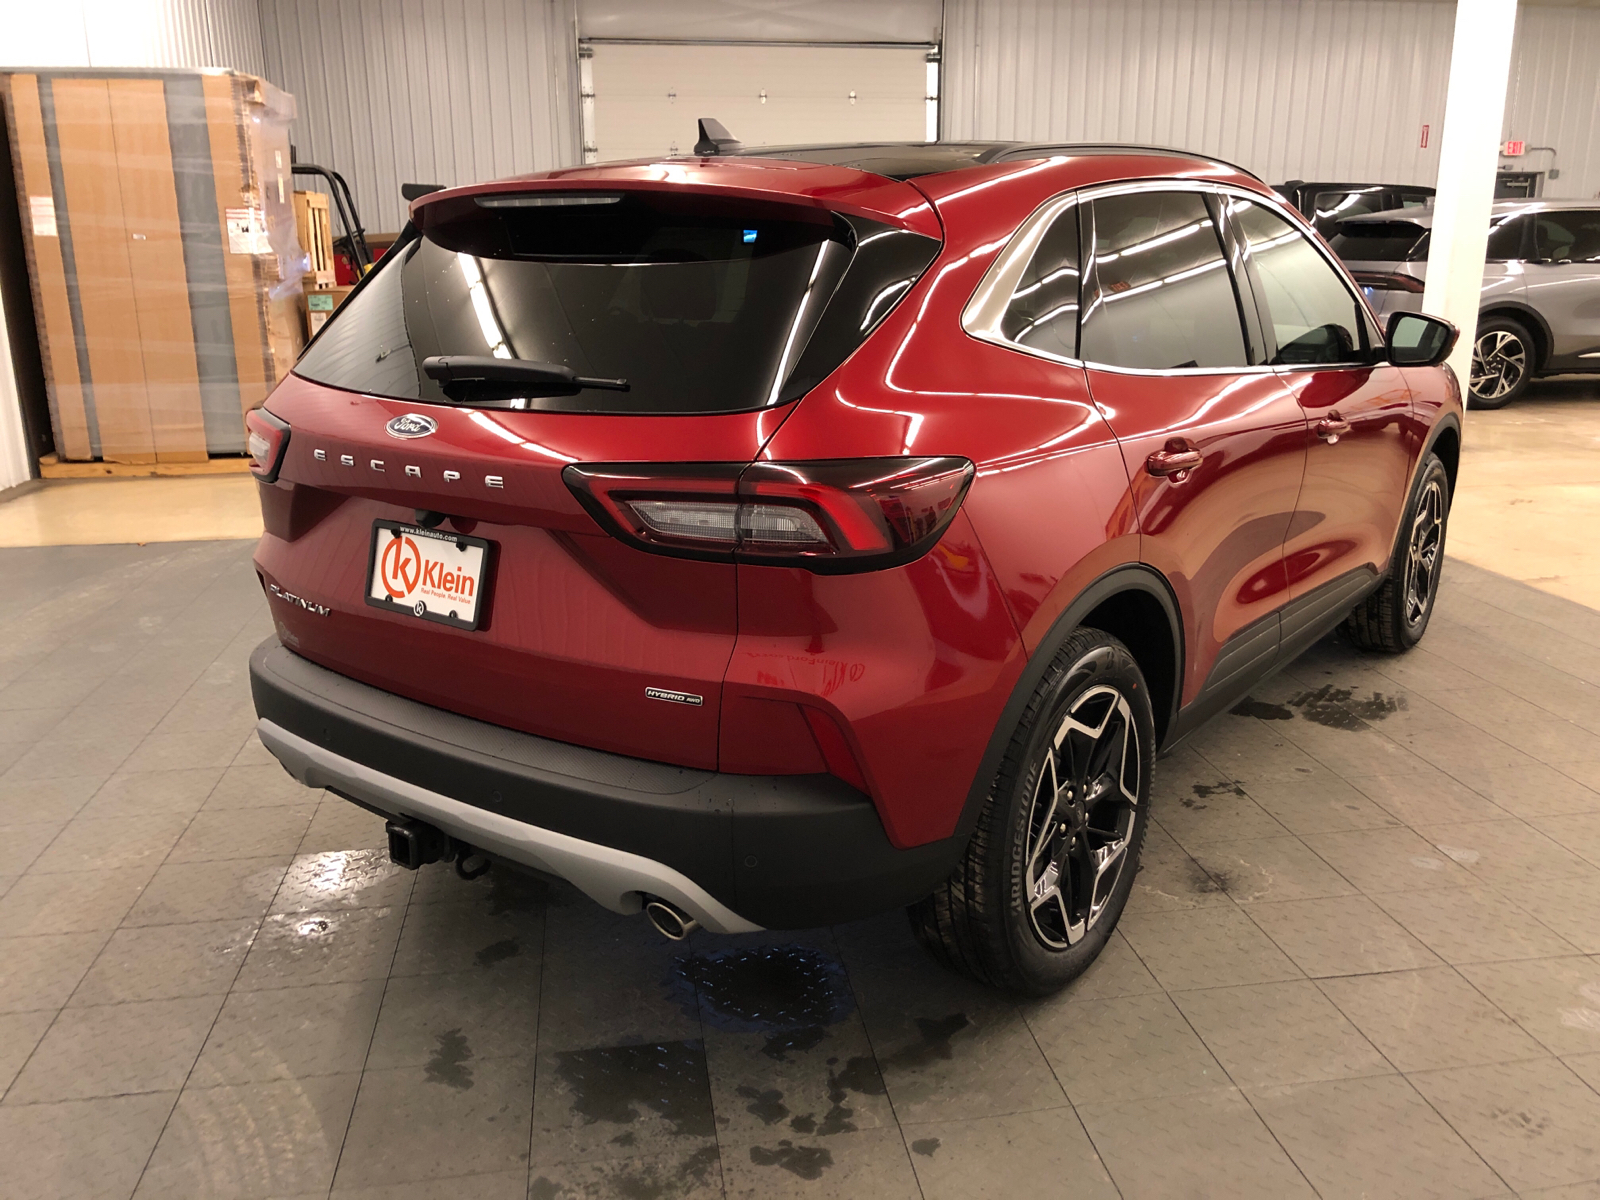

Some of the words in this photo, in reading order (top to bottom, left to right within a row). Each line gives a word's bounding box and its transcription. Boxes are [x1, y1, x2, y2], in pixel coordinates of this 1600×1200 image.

[1507, 141, 1524, 154] EXIT
[313, 448, 504, 489] ESCAPE
[400, 526, 458, 542] www.kleinauto.com
[422, 559, 475, 597] Klein
[270, 583, 331, 617] PLATINUM
[421, 587, 430, 595] Real
[447, 593, 457, 601] Real
[458, 596, 471, 604] Value
[647, 690, 685, 701] HYBRID
[1010, 759, 1038, 916] BRIDGESTONE
